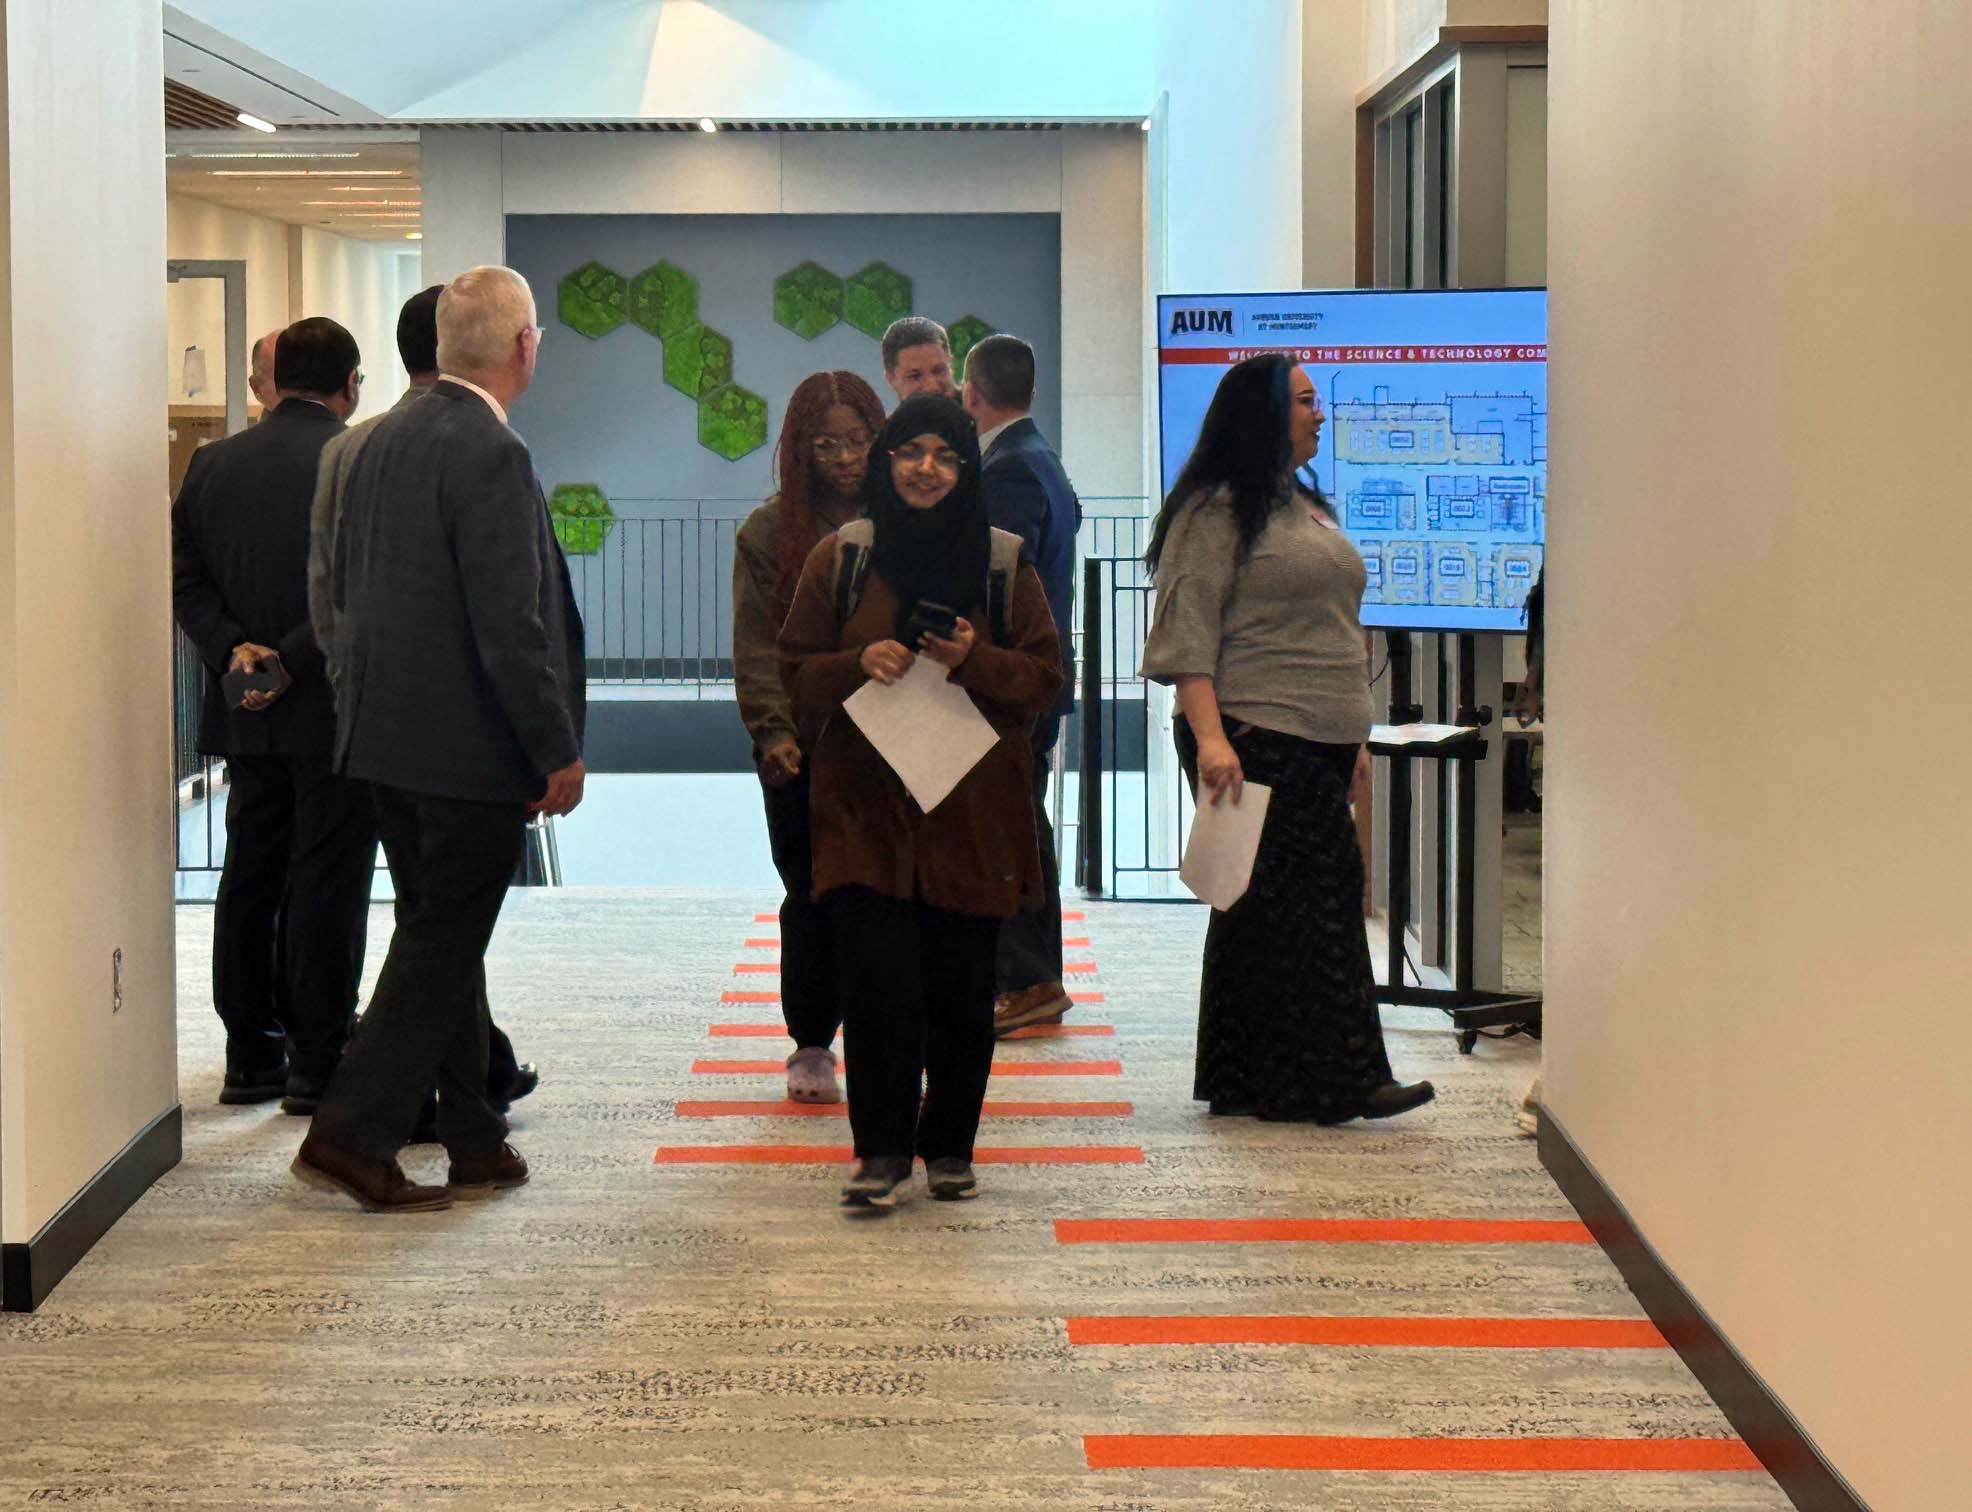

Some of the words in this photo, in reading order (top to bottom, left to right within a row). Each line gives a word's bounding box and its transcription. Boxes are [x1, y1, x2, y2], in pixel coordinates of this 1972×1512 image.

[1171, 310, 1233, 335] AUM
[1296, 349, 1311, 360] TO
[1317, 349, 1340, 360] THE
[1346, 349, 1402, 360] SCIENCE
[1406, 349, 1416, 360] &
[1421, 348, 1512, 359] TECHNOLOGY
